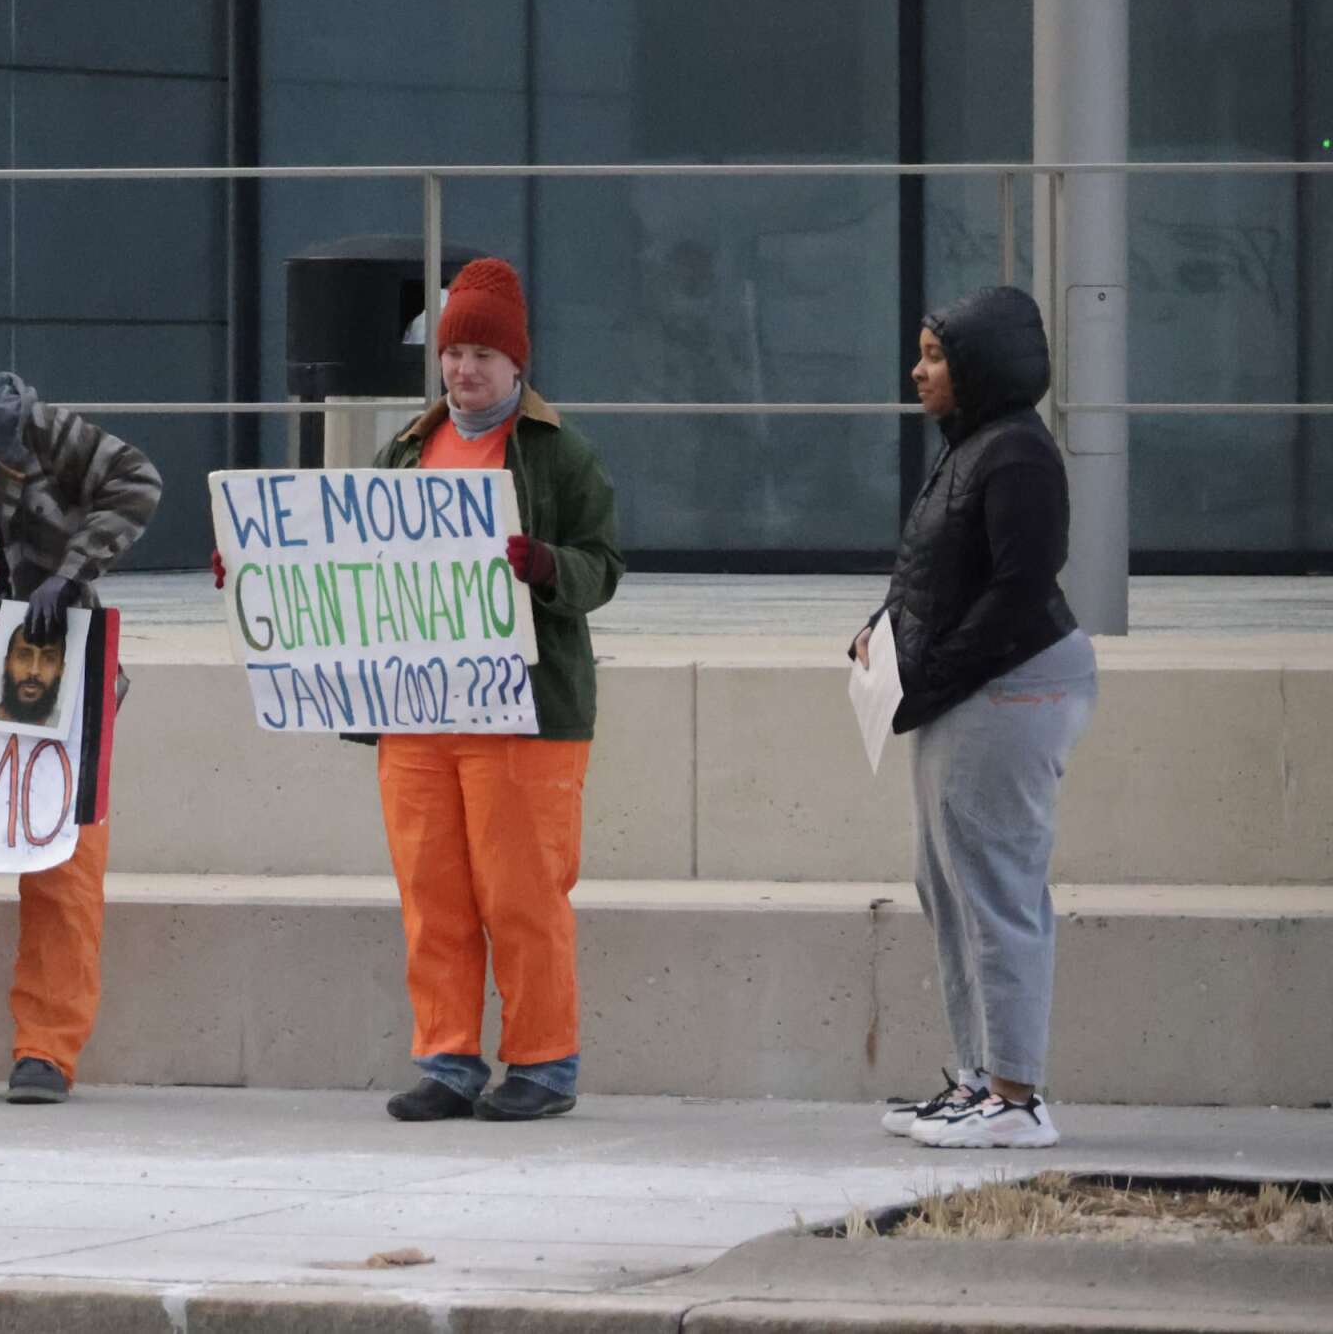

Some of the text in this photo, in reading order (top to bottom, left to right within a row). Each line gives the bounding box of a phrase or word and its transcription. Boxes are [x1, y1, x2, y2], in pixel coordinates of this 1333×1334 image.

[221, 473, 497, 550] WE MOURN
[246, 659, 356, 729] JAN
